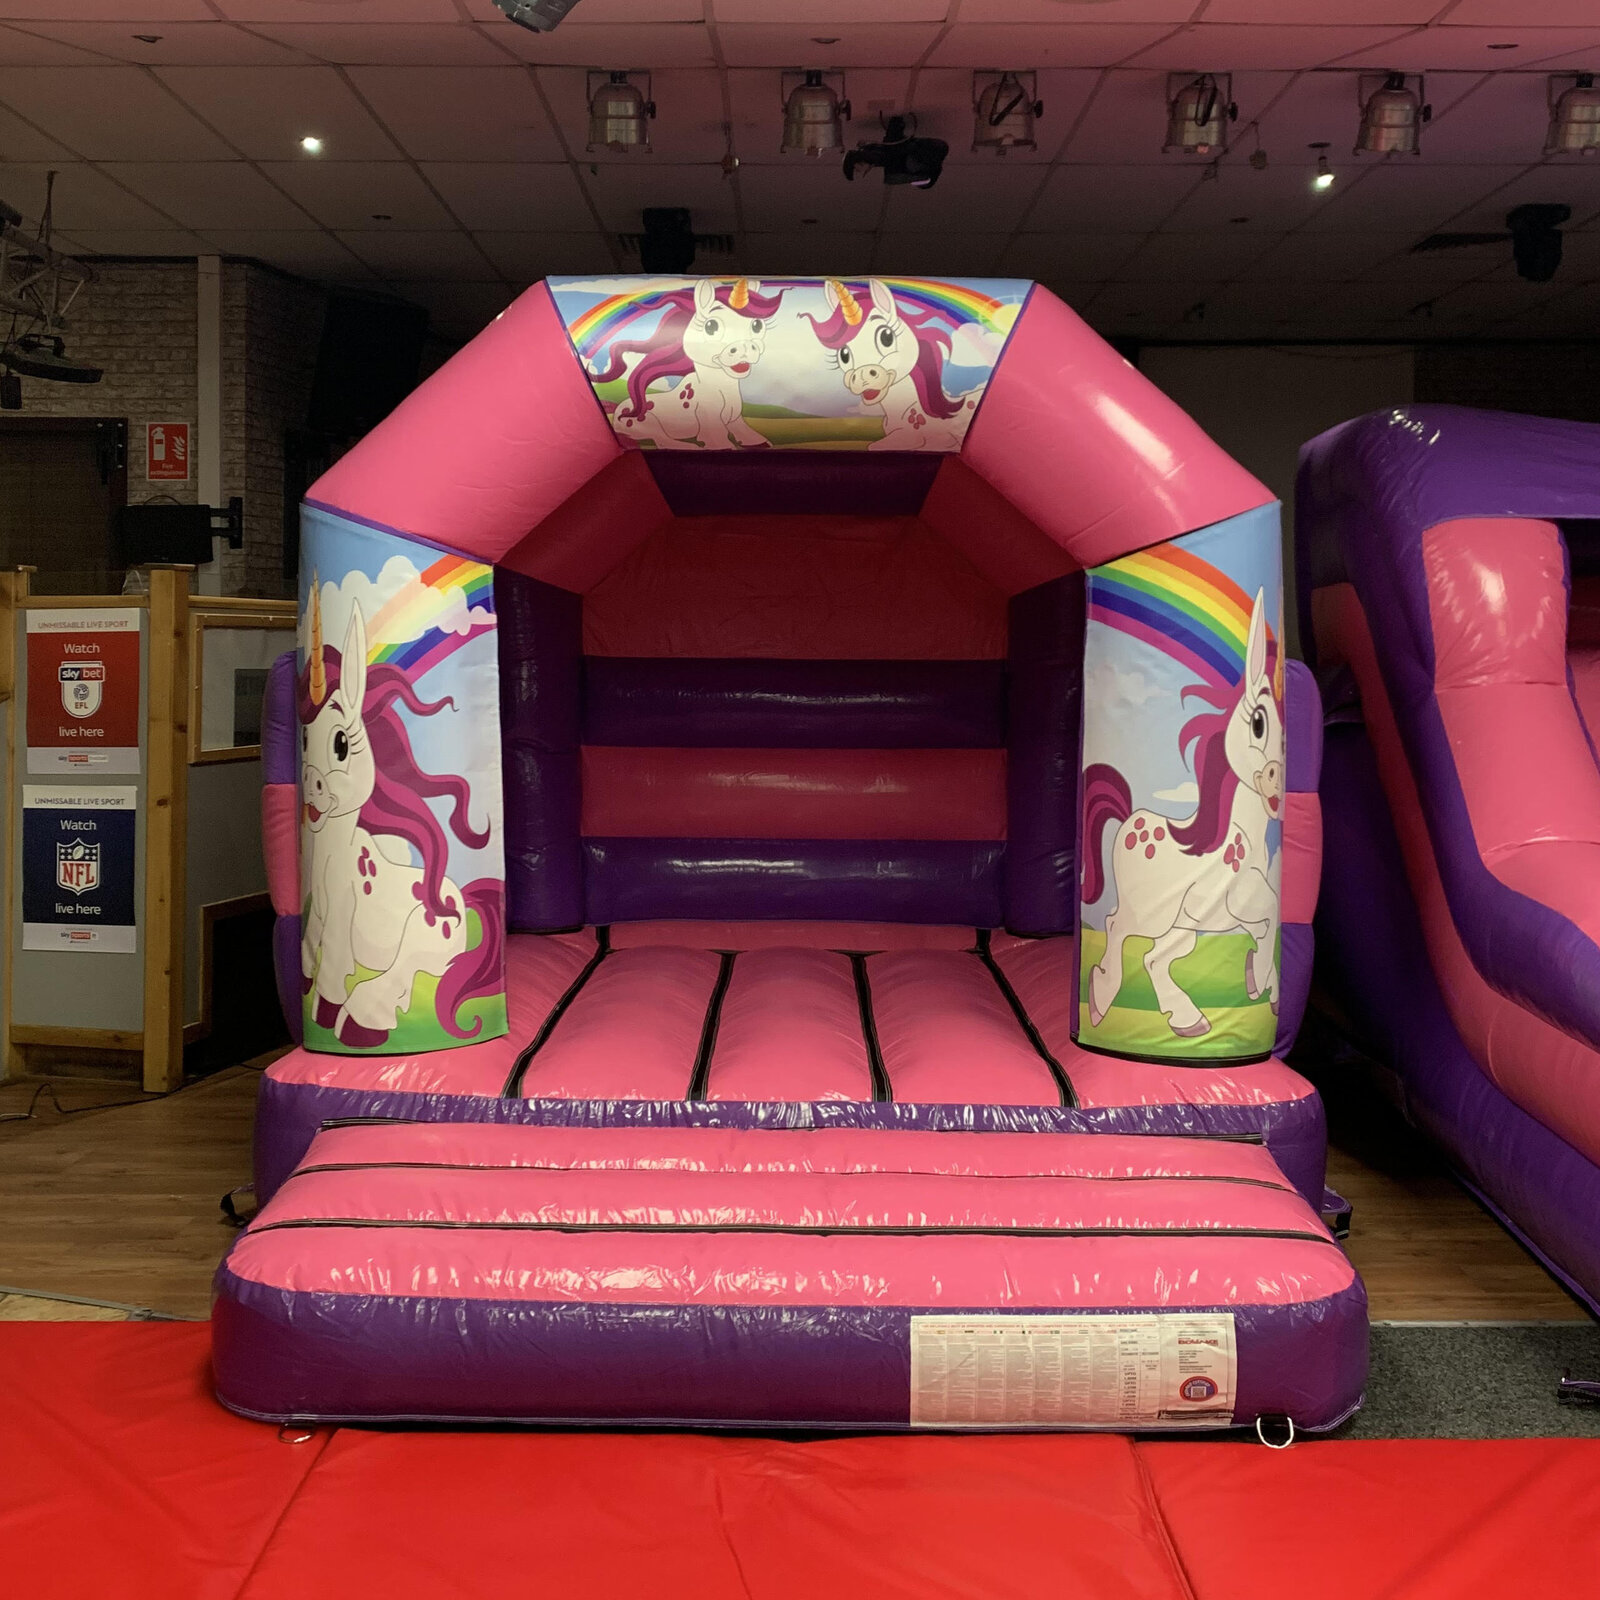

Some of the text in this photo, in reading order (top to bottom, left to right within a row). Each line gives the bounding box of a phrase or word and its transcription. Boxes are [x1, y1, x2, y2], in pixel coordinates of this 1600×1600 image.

[37, 621, 85, 629] UNMISSABLE
[104, 620, 129, 628] SPORT
[63, 643, 100, 654] Watch
[61, 668, 101, 680] sky bet
[74, 701, 89, 709] EFL
[58, 726, 105, 737] live here
[35, 797, 82, 805] UNMISSABLE
[101, 798, 125, 806] SPORT
[60, 820, 97, 831] Watch
[62, 862, 95, 887] NFL
[55, 902, 102, 915] live here
